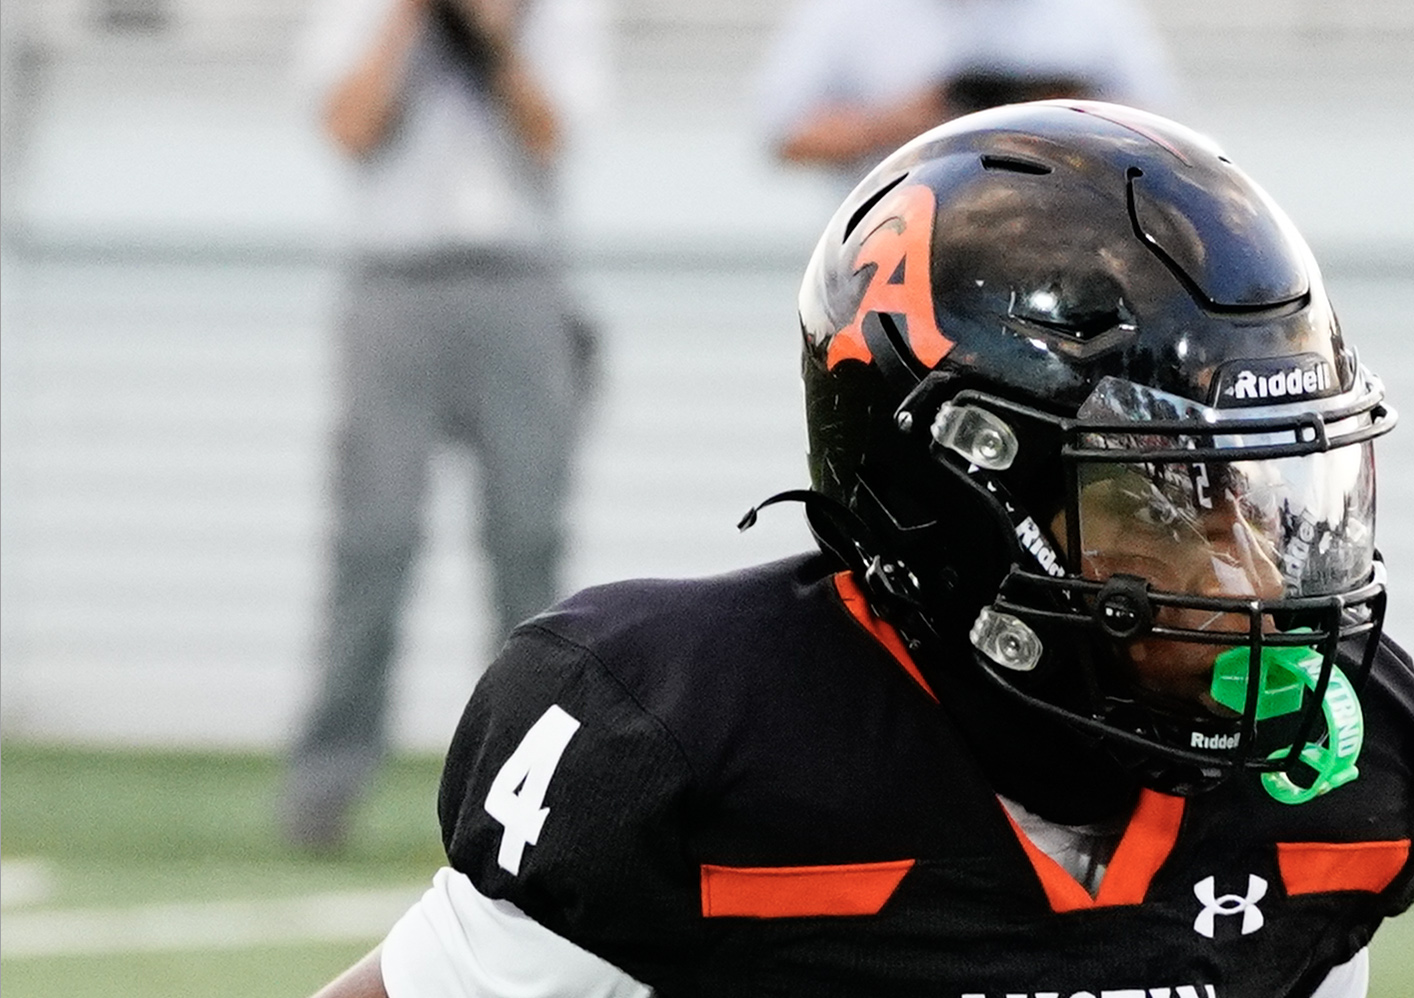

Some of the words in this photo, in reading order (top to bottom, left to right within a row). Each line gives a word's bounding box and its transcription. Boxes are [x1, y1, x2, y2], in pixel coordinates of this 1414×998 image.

[827, 184, 957, 371] A
[1234, 363, 1331, 399] Riddell
[1014, 516, 1066, 578] Ridd
[484, 703, 581, 877] 4
